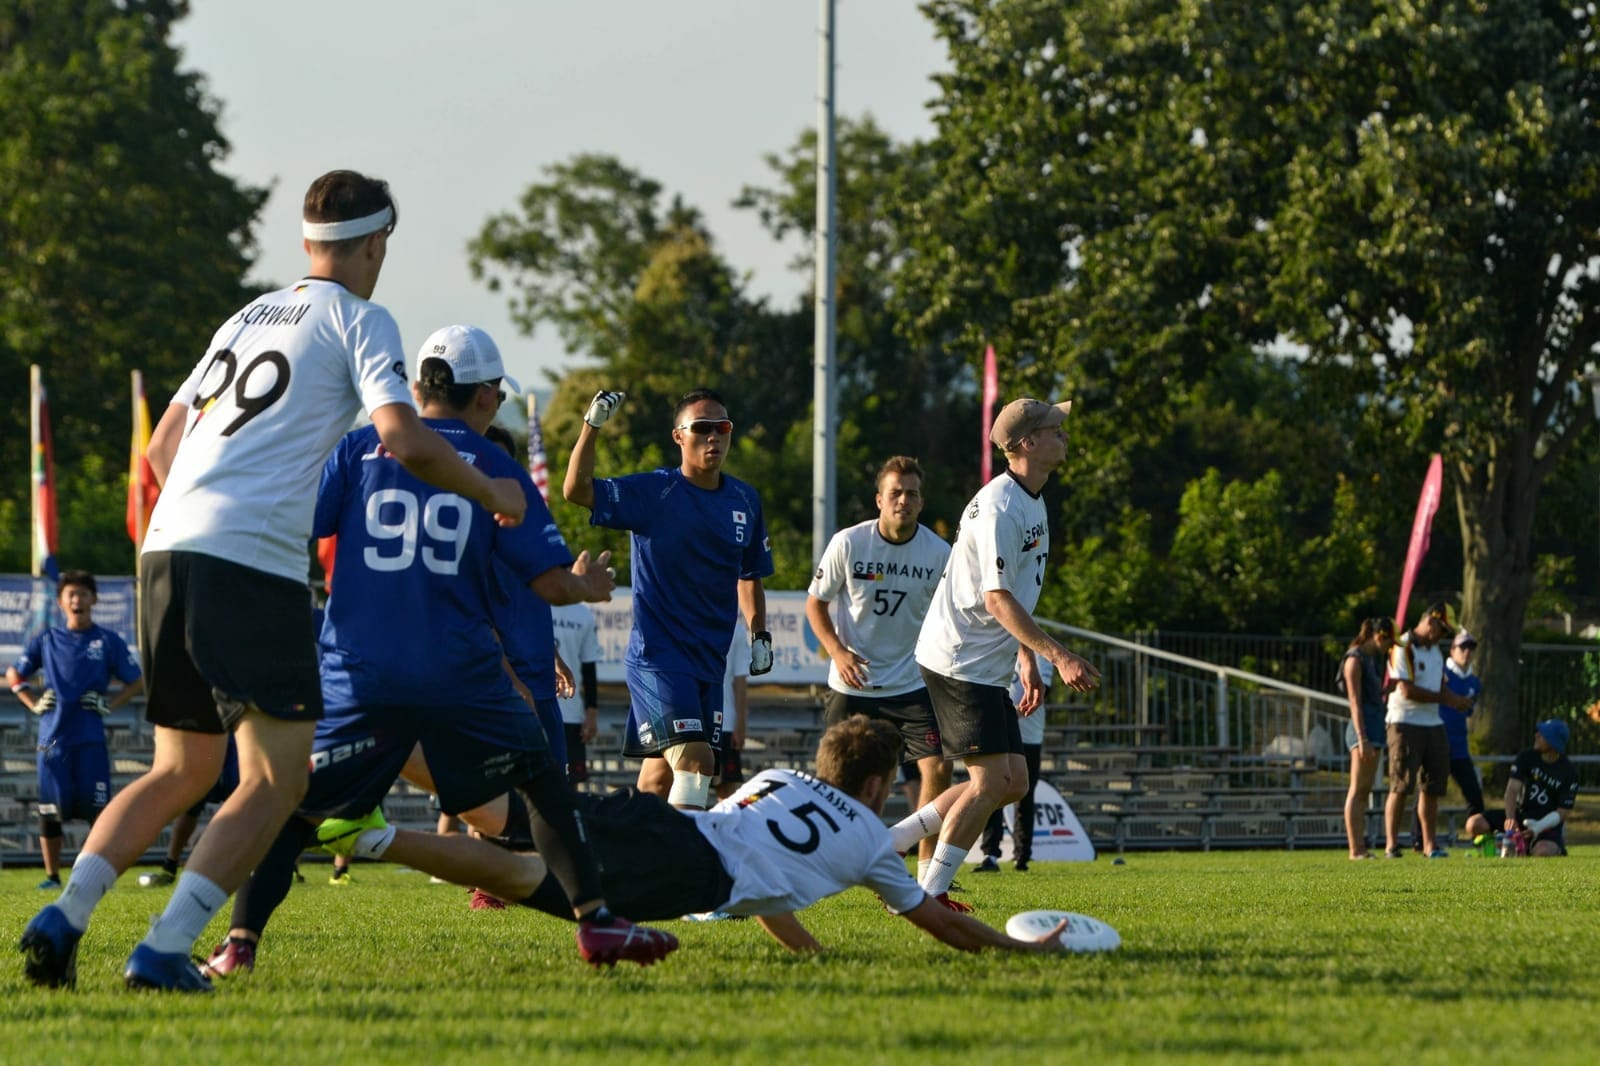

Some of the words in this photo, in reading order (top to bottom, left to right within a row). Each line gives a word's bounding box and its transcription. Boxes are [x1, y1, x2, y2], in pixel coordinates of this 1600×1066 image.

[433, 345, 447, 355] 99
[186, 350, 291, 437] 99
[363, 488, 473, 576] 99
[735, 526, 744, 543] 5
[853, 561, 934, 580] GERMANY
[873, 589, 907, 616] 57
[711, 727, 721, 743] 5
[1529, 784, 1549, 805] 96
[737, 779, 841, 854] 15
